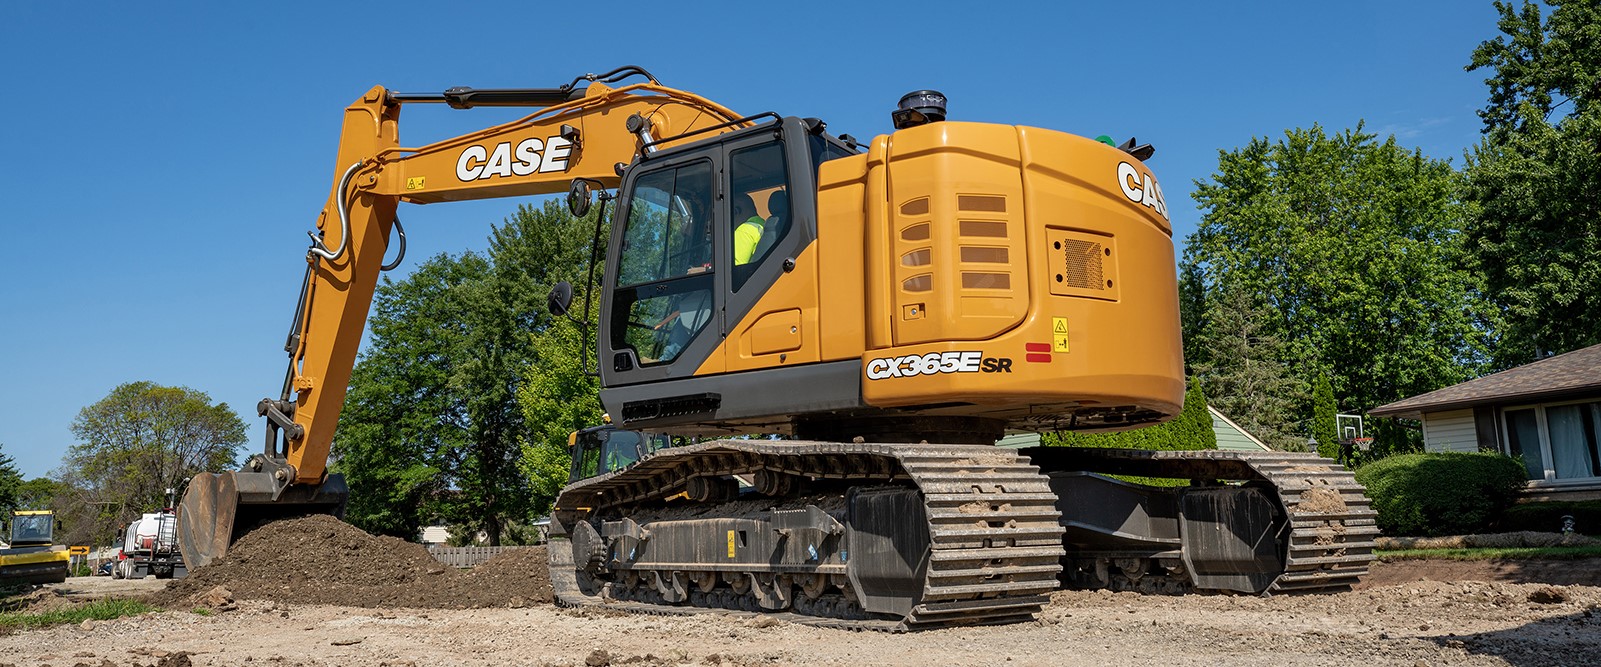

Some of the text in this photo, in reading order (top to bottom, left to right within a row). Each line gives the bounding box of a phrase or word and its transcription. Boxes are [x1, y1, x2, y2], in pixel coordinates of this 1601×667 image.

[456, 135, 572, 182] CASE
[866, 351, 1013, 380] CX365E SR
